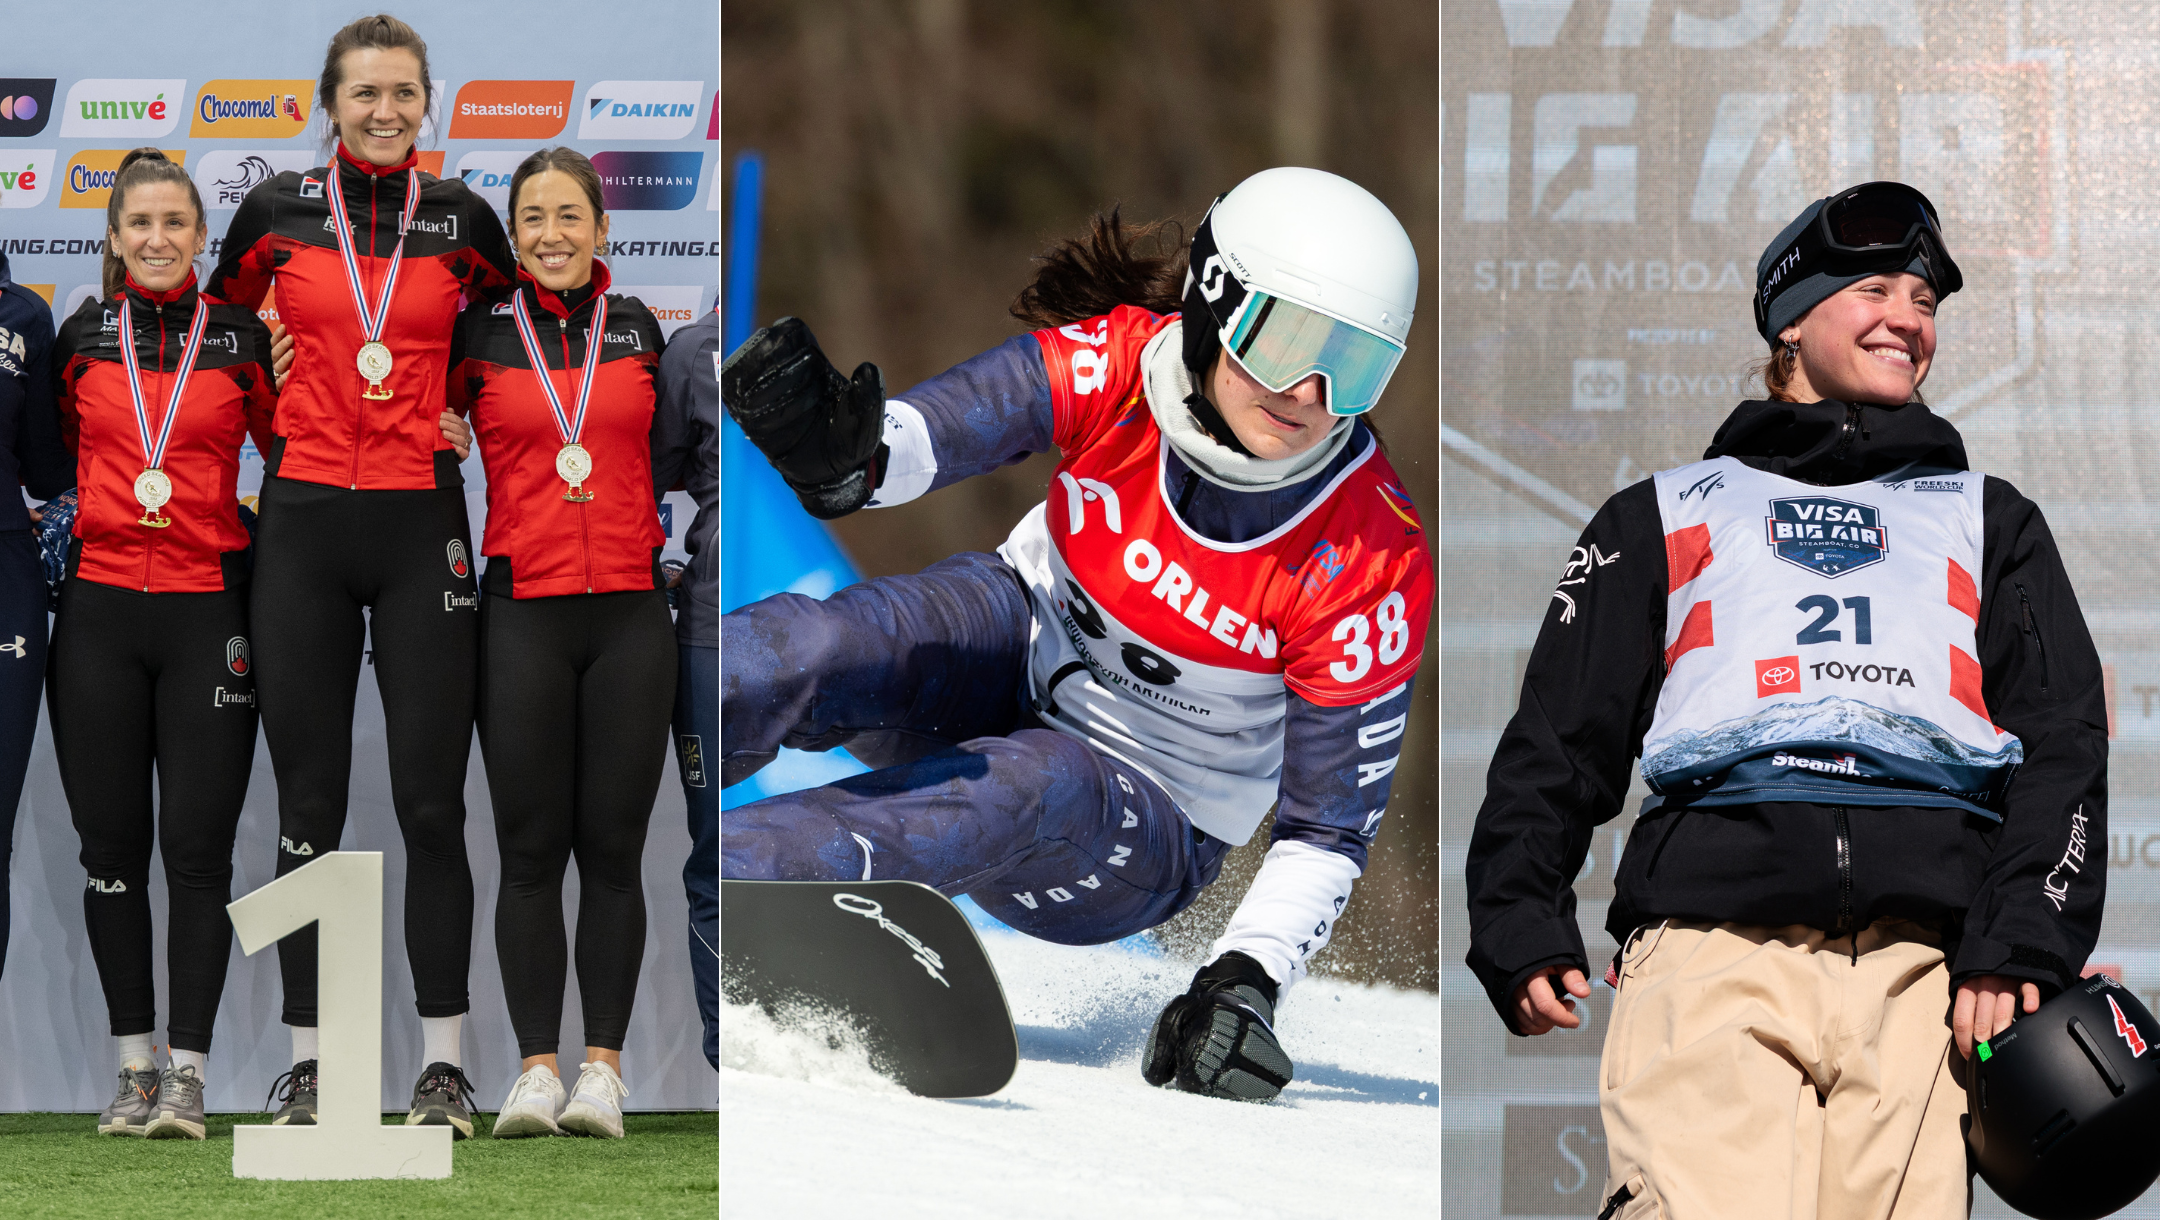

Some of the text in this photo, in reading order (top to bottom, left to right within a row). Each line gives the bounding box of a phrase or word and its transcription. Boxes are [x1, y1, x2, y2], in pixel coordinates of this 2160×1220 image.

[81, 93, 166, 121] univé
[200, 94, 277, 123] Chocomel
[460, 102, 563, 118] Staatsloterij
[610, 103, 695, 118] DAIKIN
[1441, 93, 1637, 222] IG
[606, 176, 692, 186] HILTERMANN
[0, 239, 104, 254] ING.COM
[607, 241, 718, 256] KATING.C
[1229, 252, 1252, 278] SCOTT
[1474, 260, 1757, 291] STEAMBOA
[1762, 246, 1801, 305] SMITH
[1639, 374, 1768, 396] TOYOT
[1786, 503, 1864, 525] VISA
[1776, 522, 1879, 545] BIG AIR
[1799, 541, 1847, 549] STEAMBOAT,
[1124, 539, 1277, 659] ORLEN
[1795, 594, 1872, 646] 21
[1329, 590, 1409, 683] 38
[1809, 661, 1916, 688] TOYOTA
[688, 770, 701, 781] JSF
[1772, 751, 1872, 778] Steamb
[281, 836, 313, 855] FILA
[88, 876, 126, 893] FILA
[226, 851, 453, 1180] 1
[1994, 1032, 2018, 1051] Method
